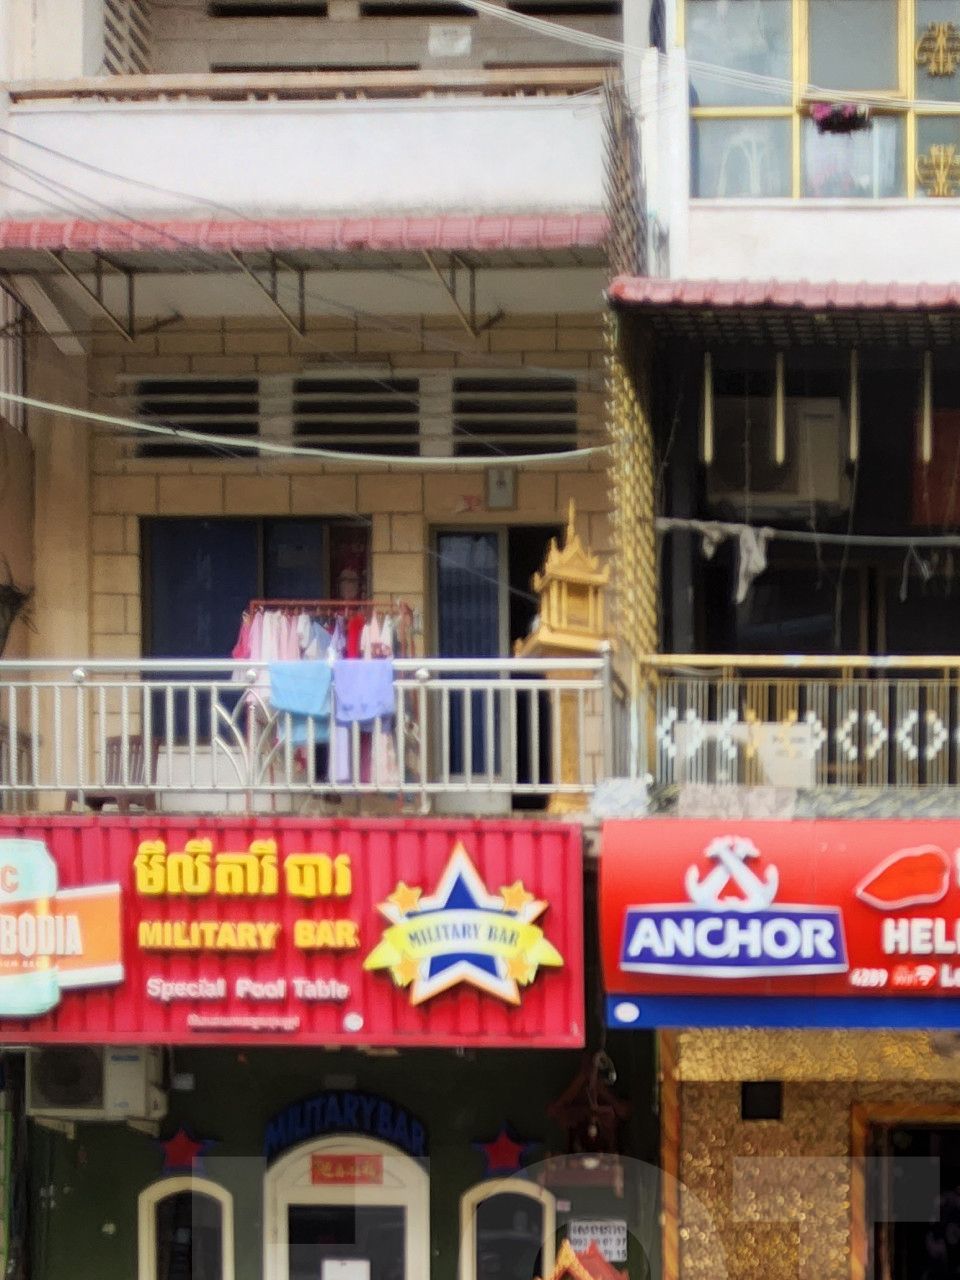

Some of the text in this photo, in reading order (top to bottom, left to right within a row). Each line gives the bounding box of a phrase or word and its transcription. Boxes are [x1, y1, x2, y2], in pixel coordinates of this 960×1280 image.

[138, 919, 359, 949] MILITARY BAR
[408, 923, 519, 948] MILITARY BAR
[627, 917, 837, 960] ANCHOR
[147, 977, 351, 1001] Special Pool Table
[263, 1091, 428, 1157] MILITARY BAR
